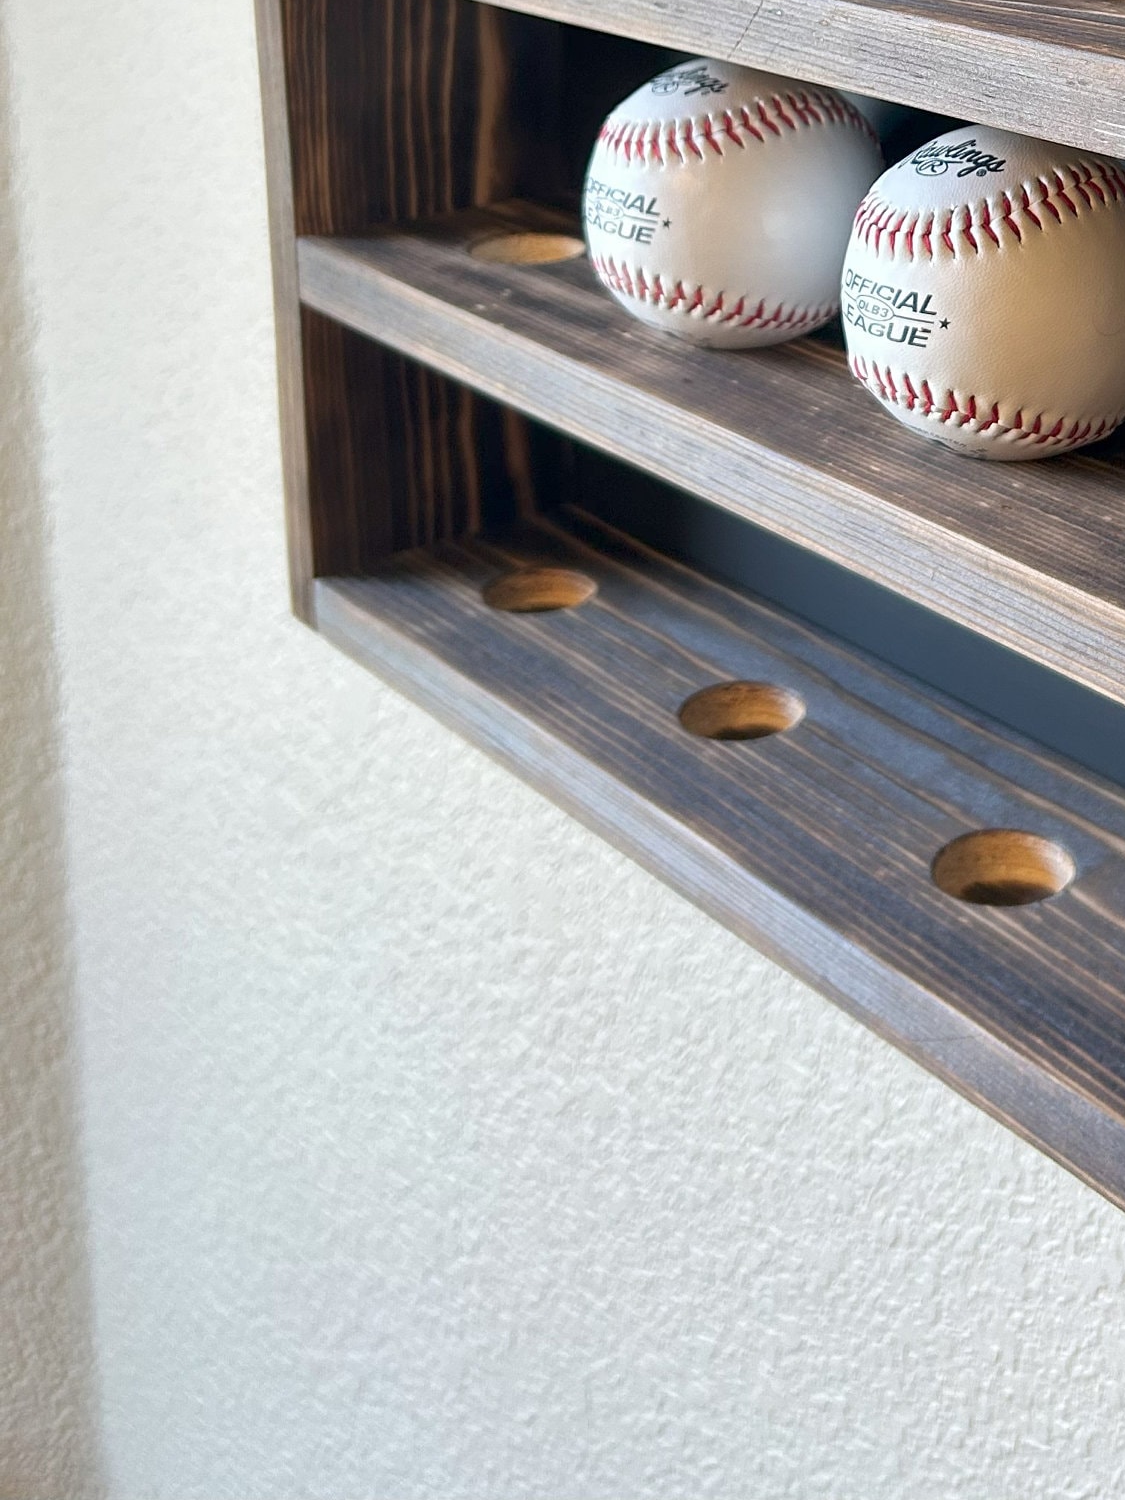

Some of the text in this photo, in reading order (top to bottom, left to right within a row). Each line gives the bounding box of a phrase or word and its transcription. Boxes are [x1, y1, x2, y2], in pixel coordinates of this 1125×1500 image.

[586, 177, 661, 217] OFFICIAL
[845, 268, 938, 316] OFFICIAL
[858, 300, 889, 318] OLB3
